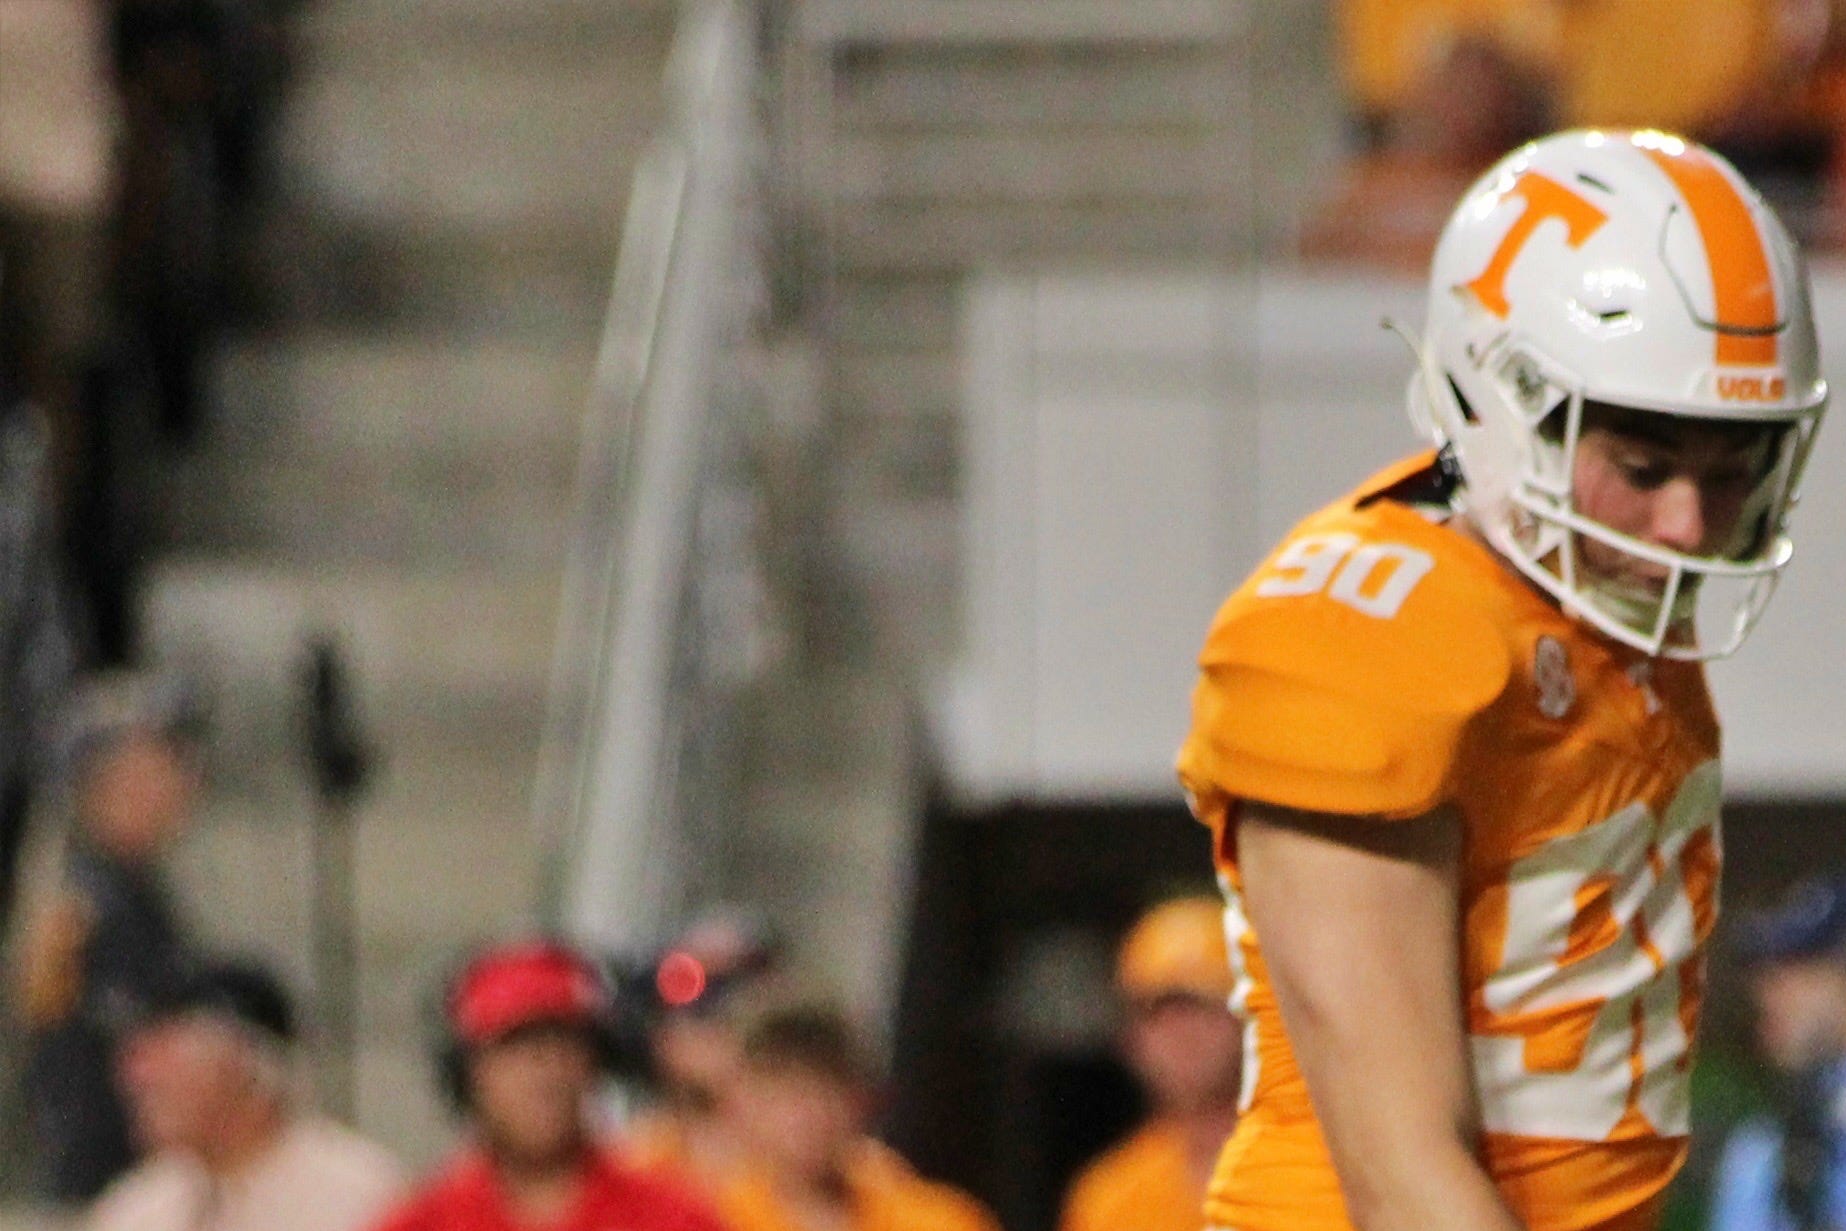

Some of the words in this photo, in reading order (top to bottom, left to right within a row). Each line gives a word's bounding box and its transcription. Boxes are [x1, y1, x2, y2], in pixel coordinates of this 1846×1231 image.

[1463, 170, 1611, 320] T
[1255, 531, 1436, 620] 90
[1470, 758, 1722, 1142] 90
